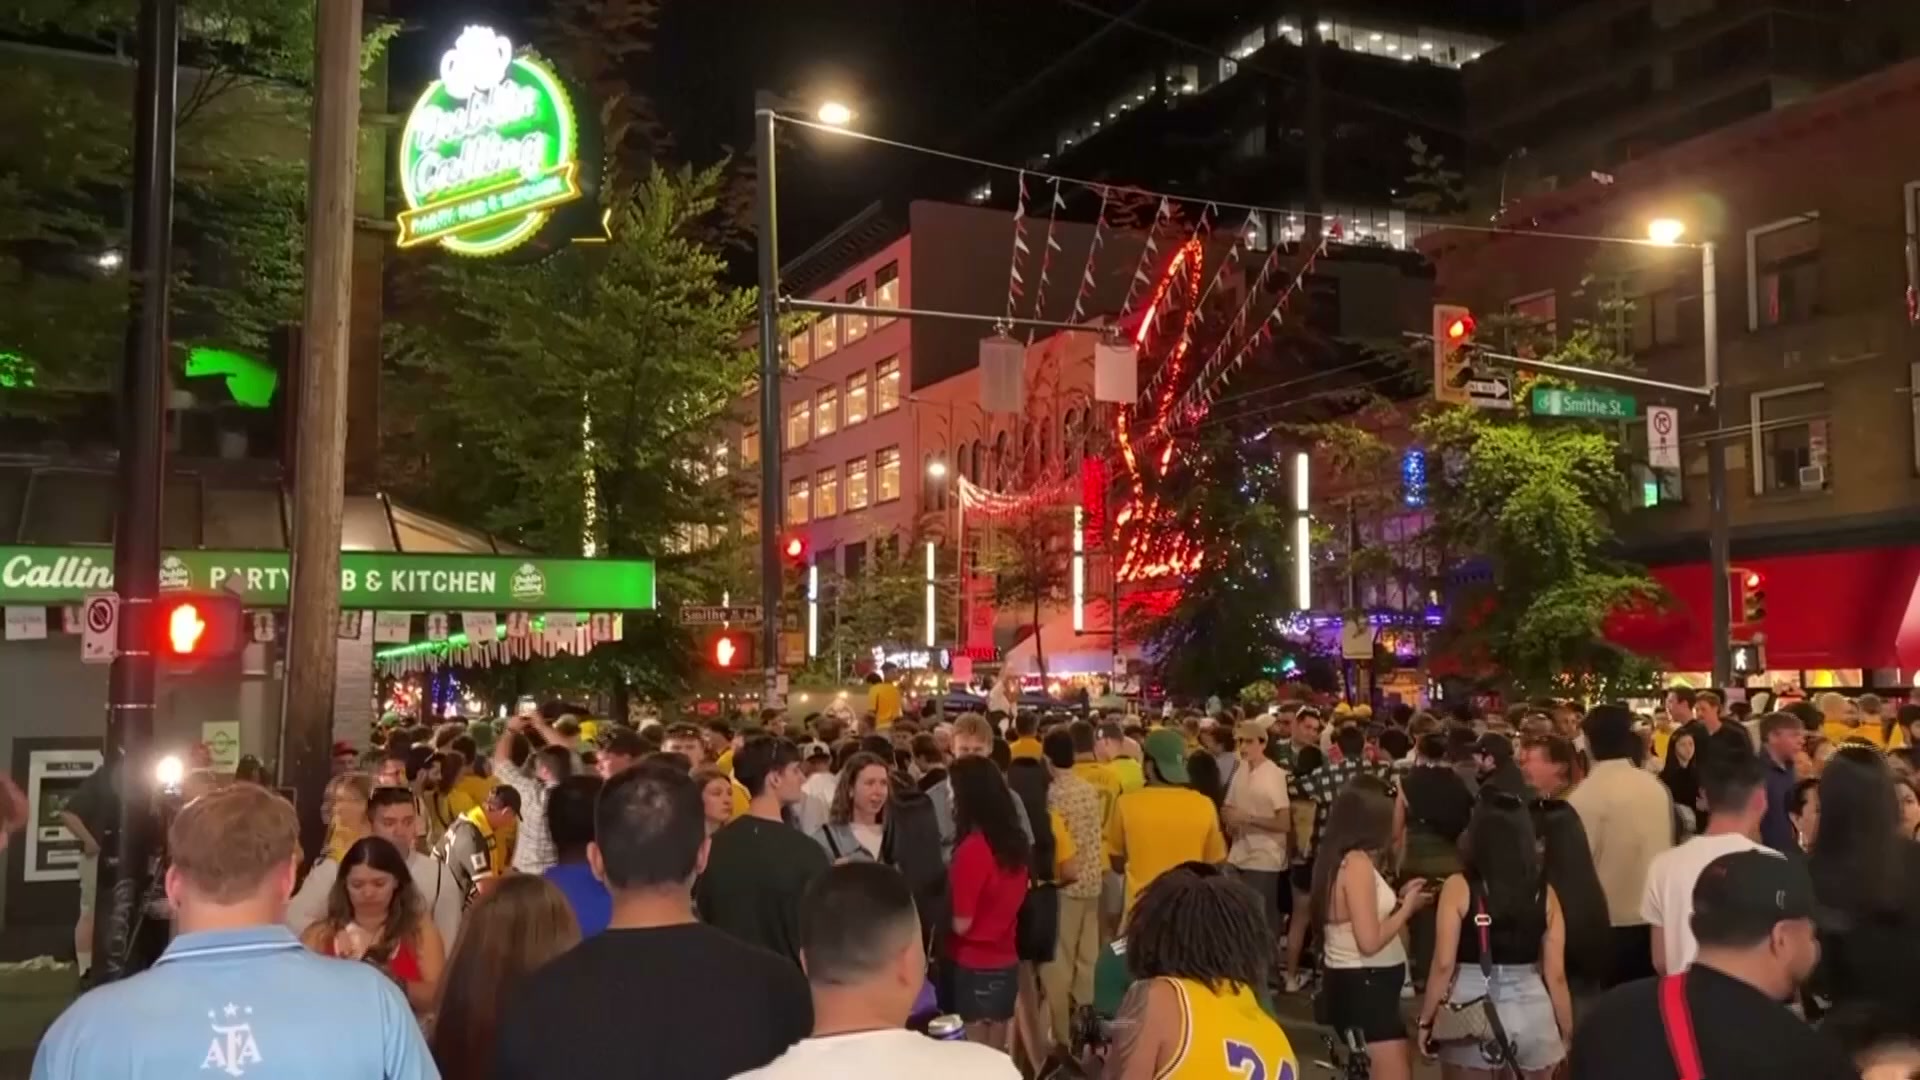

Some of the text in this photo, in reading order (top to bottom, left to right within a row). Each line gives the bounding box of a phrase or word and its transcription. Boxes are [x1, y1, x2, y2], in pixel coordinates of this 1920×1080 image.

[413, 79, 539, 151] Dublin
[414, 131, 547, 197] Calling
[1563, 396, 1626, 416] Smithe St.
[2, 555, 114, 588] Callin
[365, 570, 383, 592] &
[391, 570, 496, 593] KITCHEN
[683, 607, 727, 621] Smithe
[200, 1022, 263, 1077] AFA
[1223, 1038, 1298, 1080] 2
